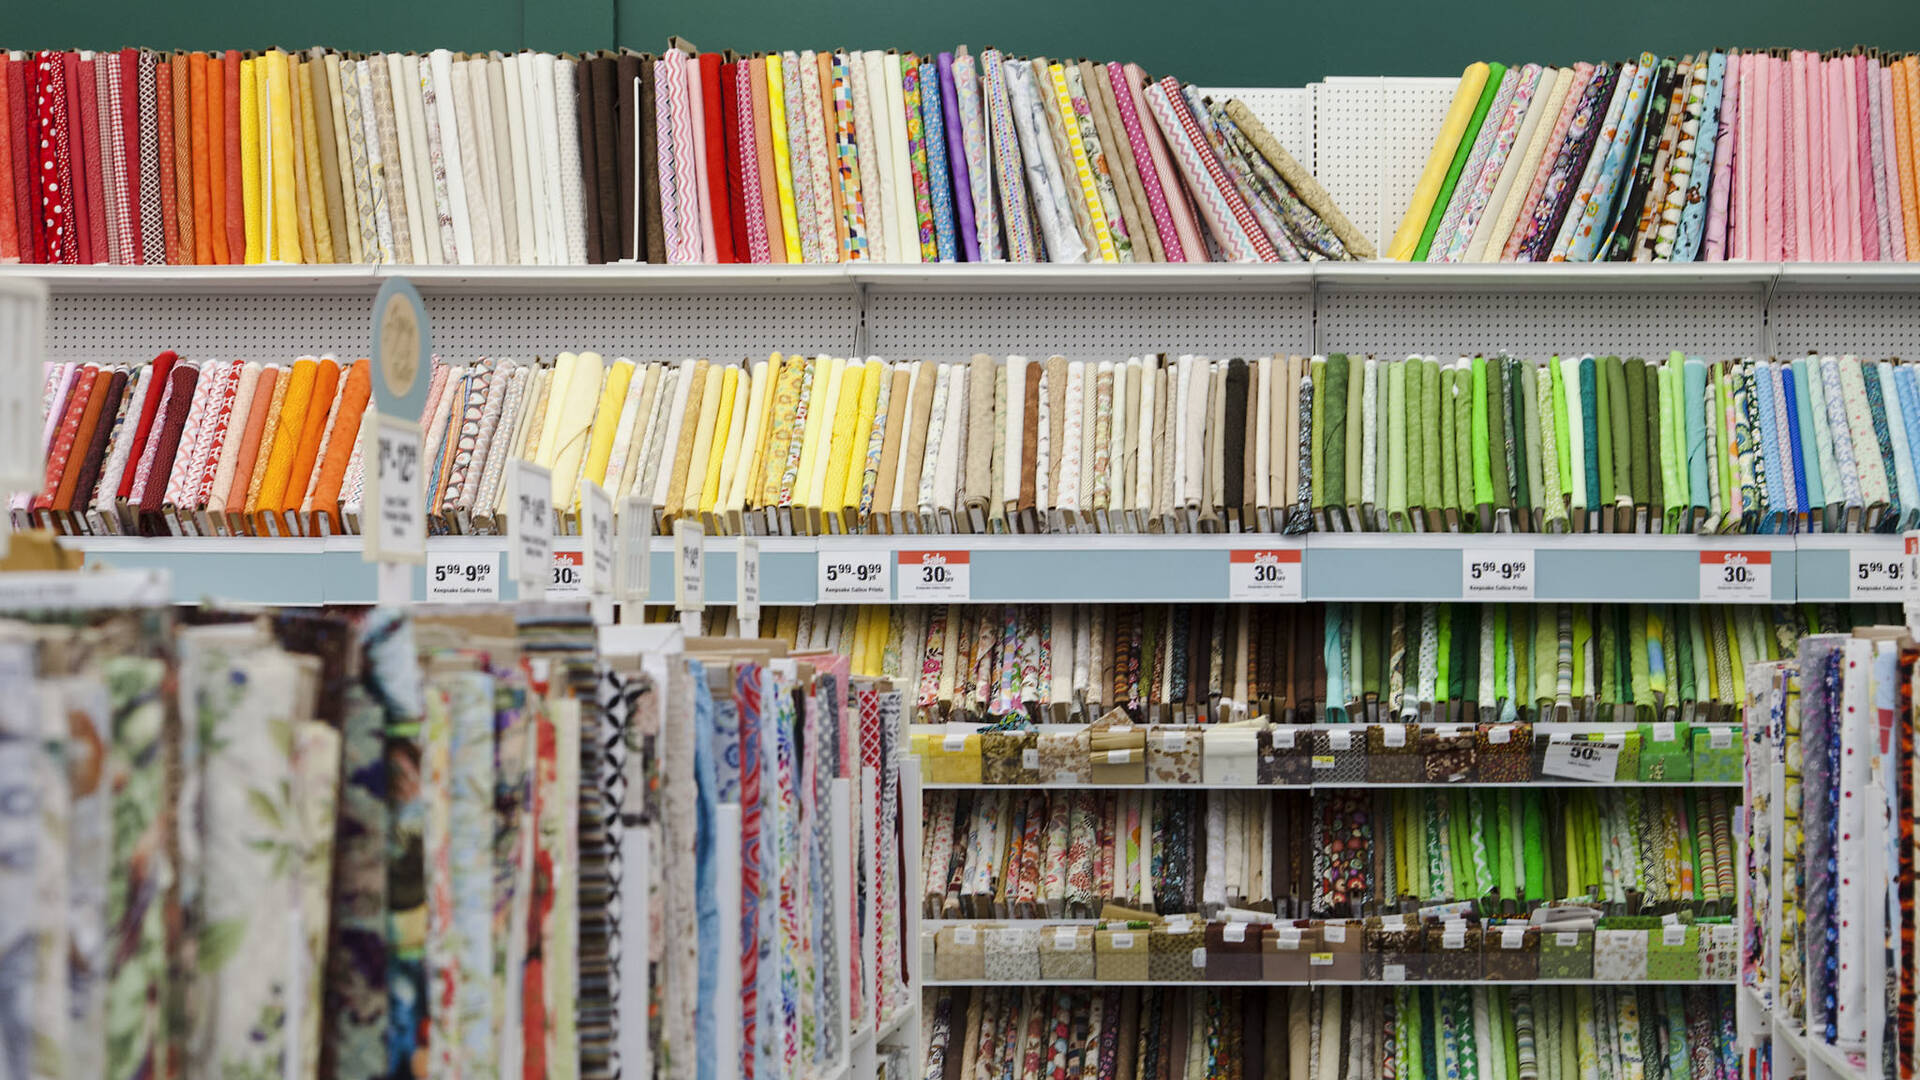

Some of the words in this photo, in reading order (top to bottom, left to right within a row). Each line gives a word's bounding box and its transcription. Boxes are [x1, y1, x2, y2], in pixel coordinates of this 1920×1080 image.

[922, 552, 947, 565] Sale
[1254, 551, 1279, 564] Sale
[1723, 552, 1749, 565] Sale
